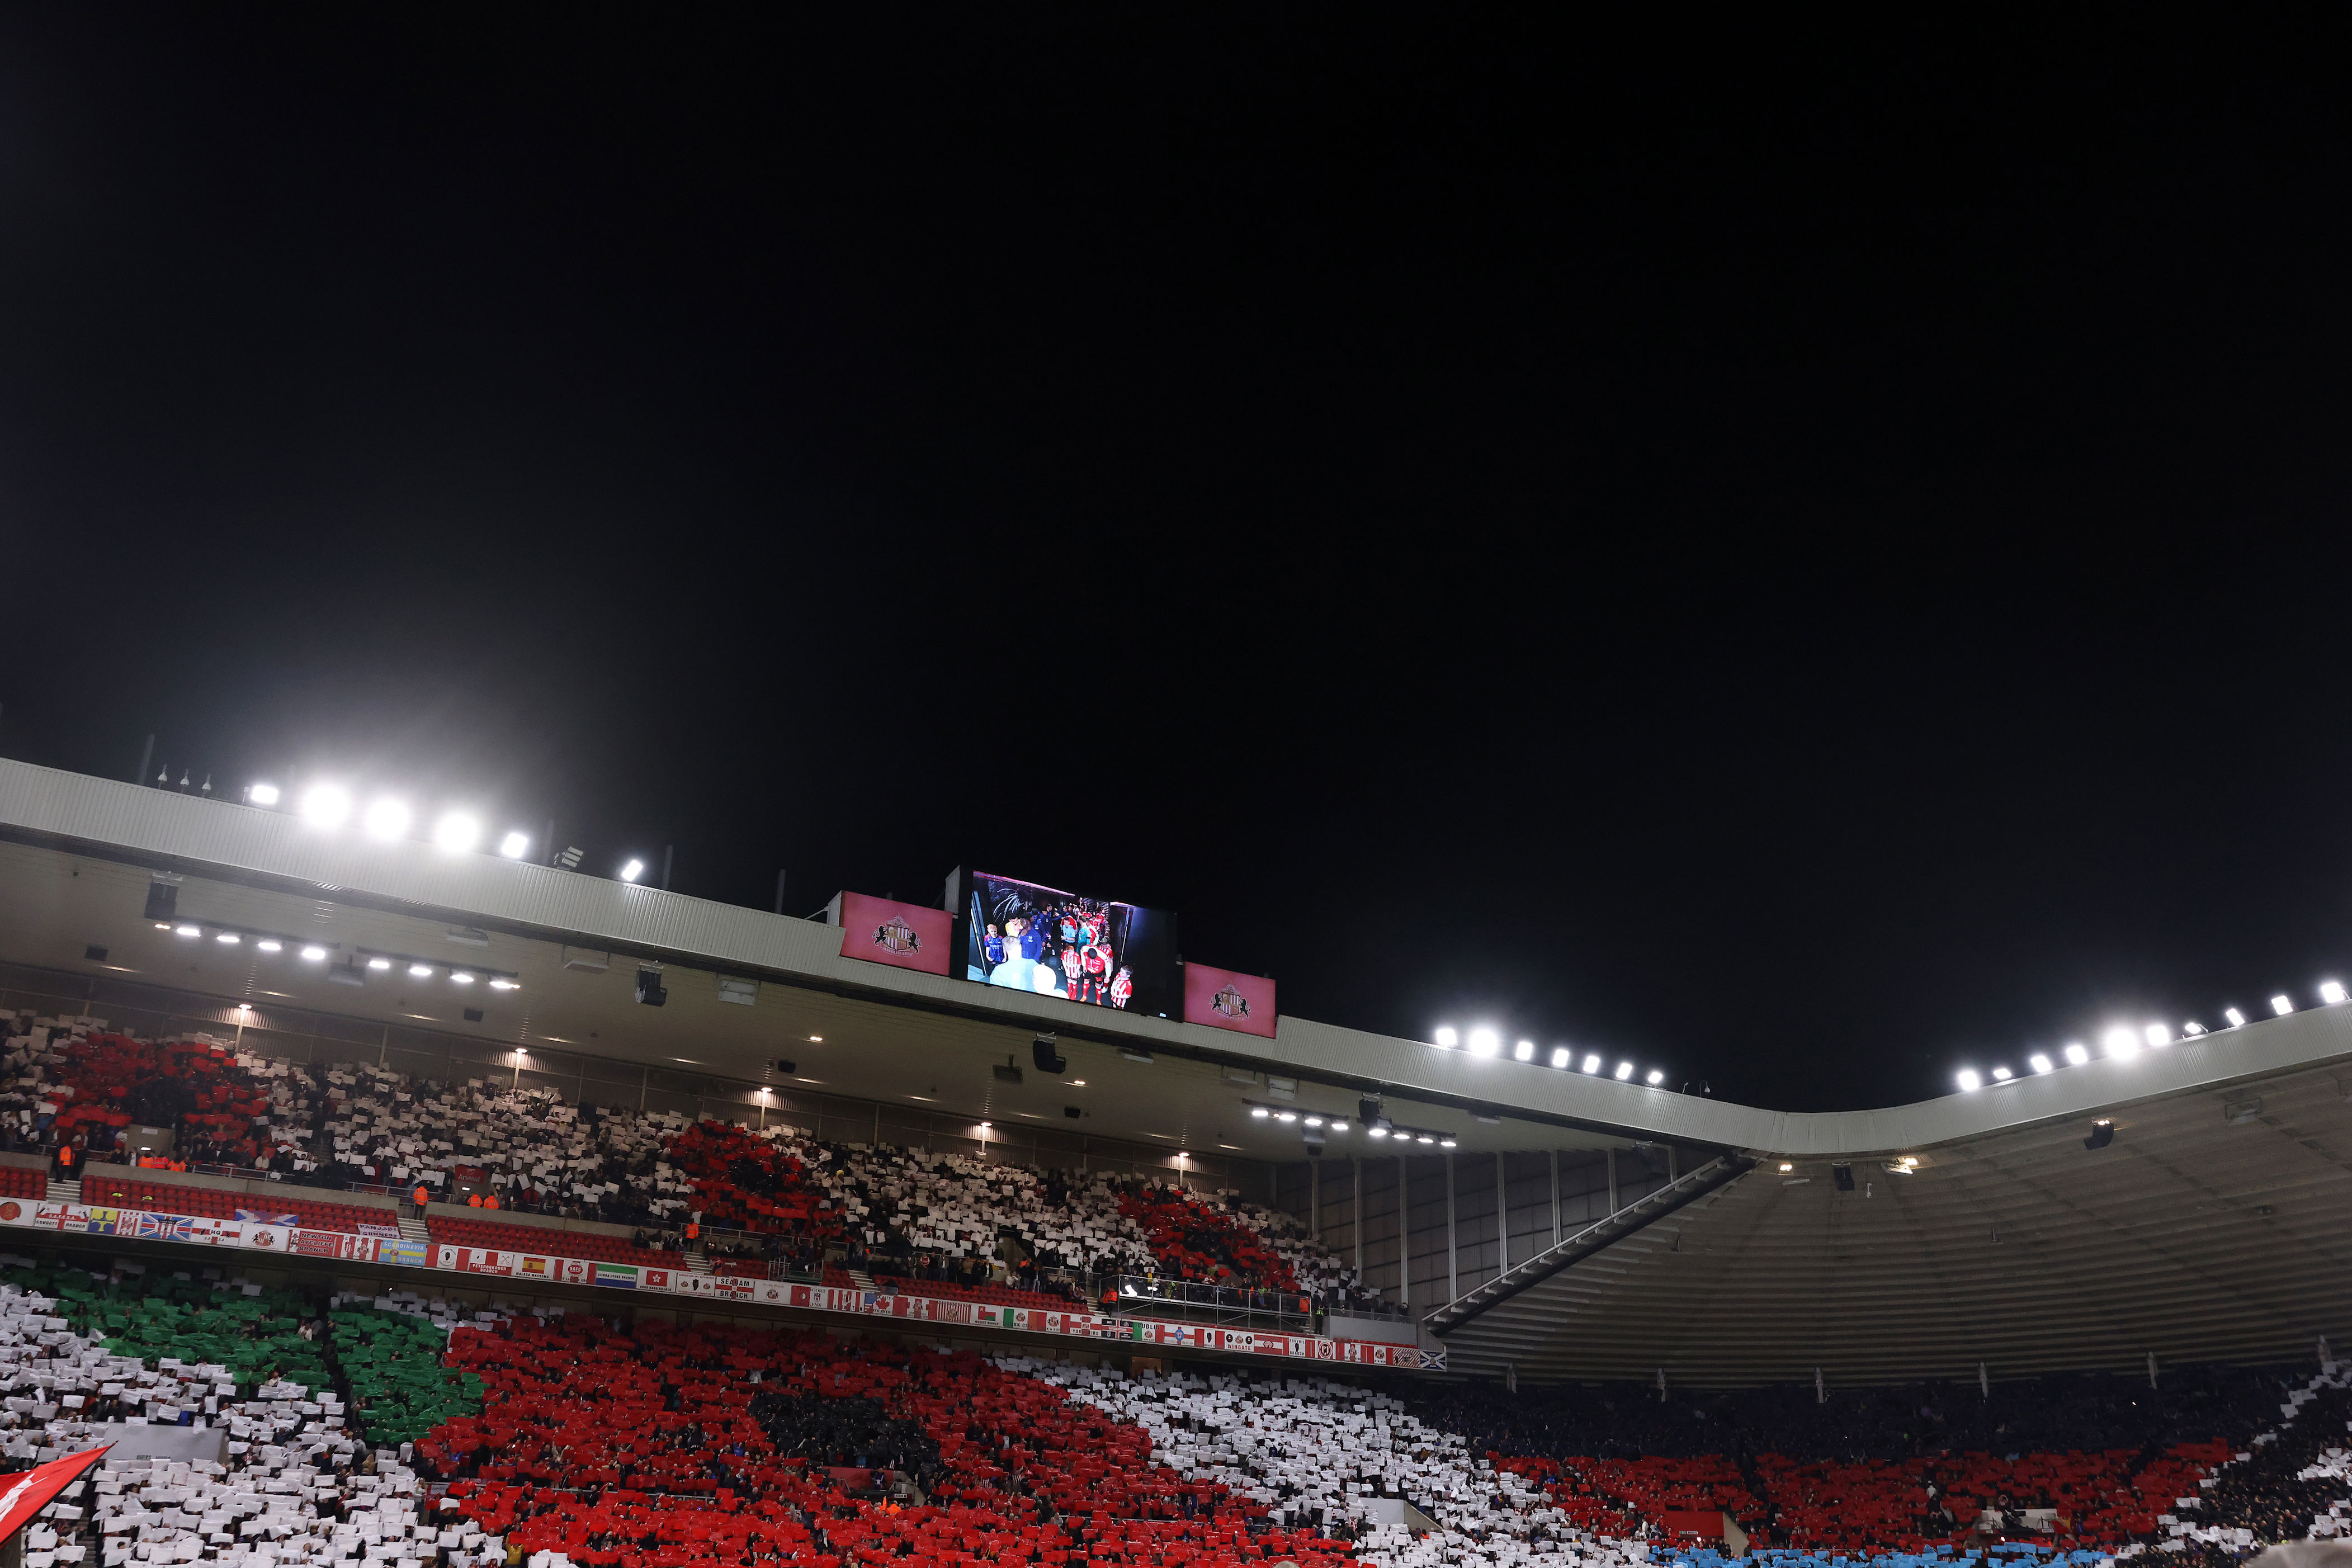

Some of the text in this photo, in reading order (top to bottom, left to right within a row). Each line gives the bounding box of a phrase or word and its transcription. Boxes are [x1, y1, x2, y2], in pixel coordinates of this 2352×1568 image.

[458, 1174, 480, 1182] Arsenal
[384, 1241, 424, 1250] SCANDINAVIA
[720, 1278, 749, 1287] SEAHAM
[720, 1290, 748, 1299] BRANCH
